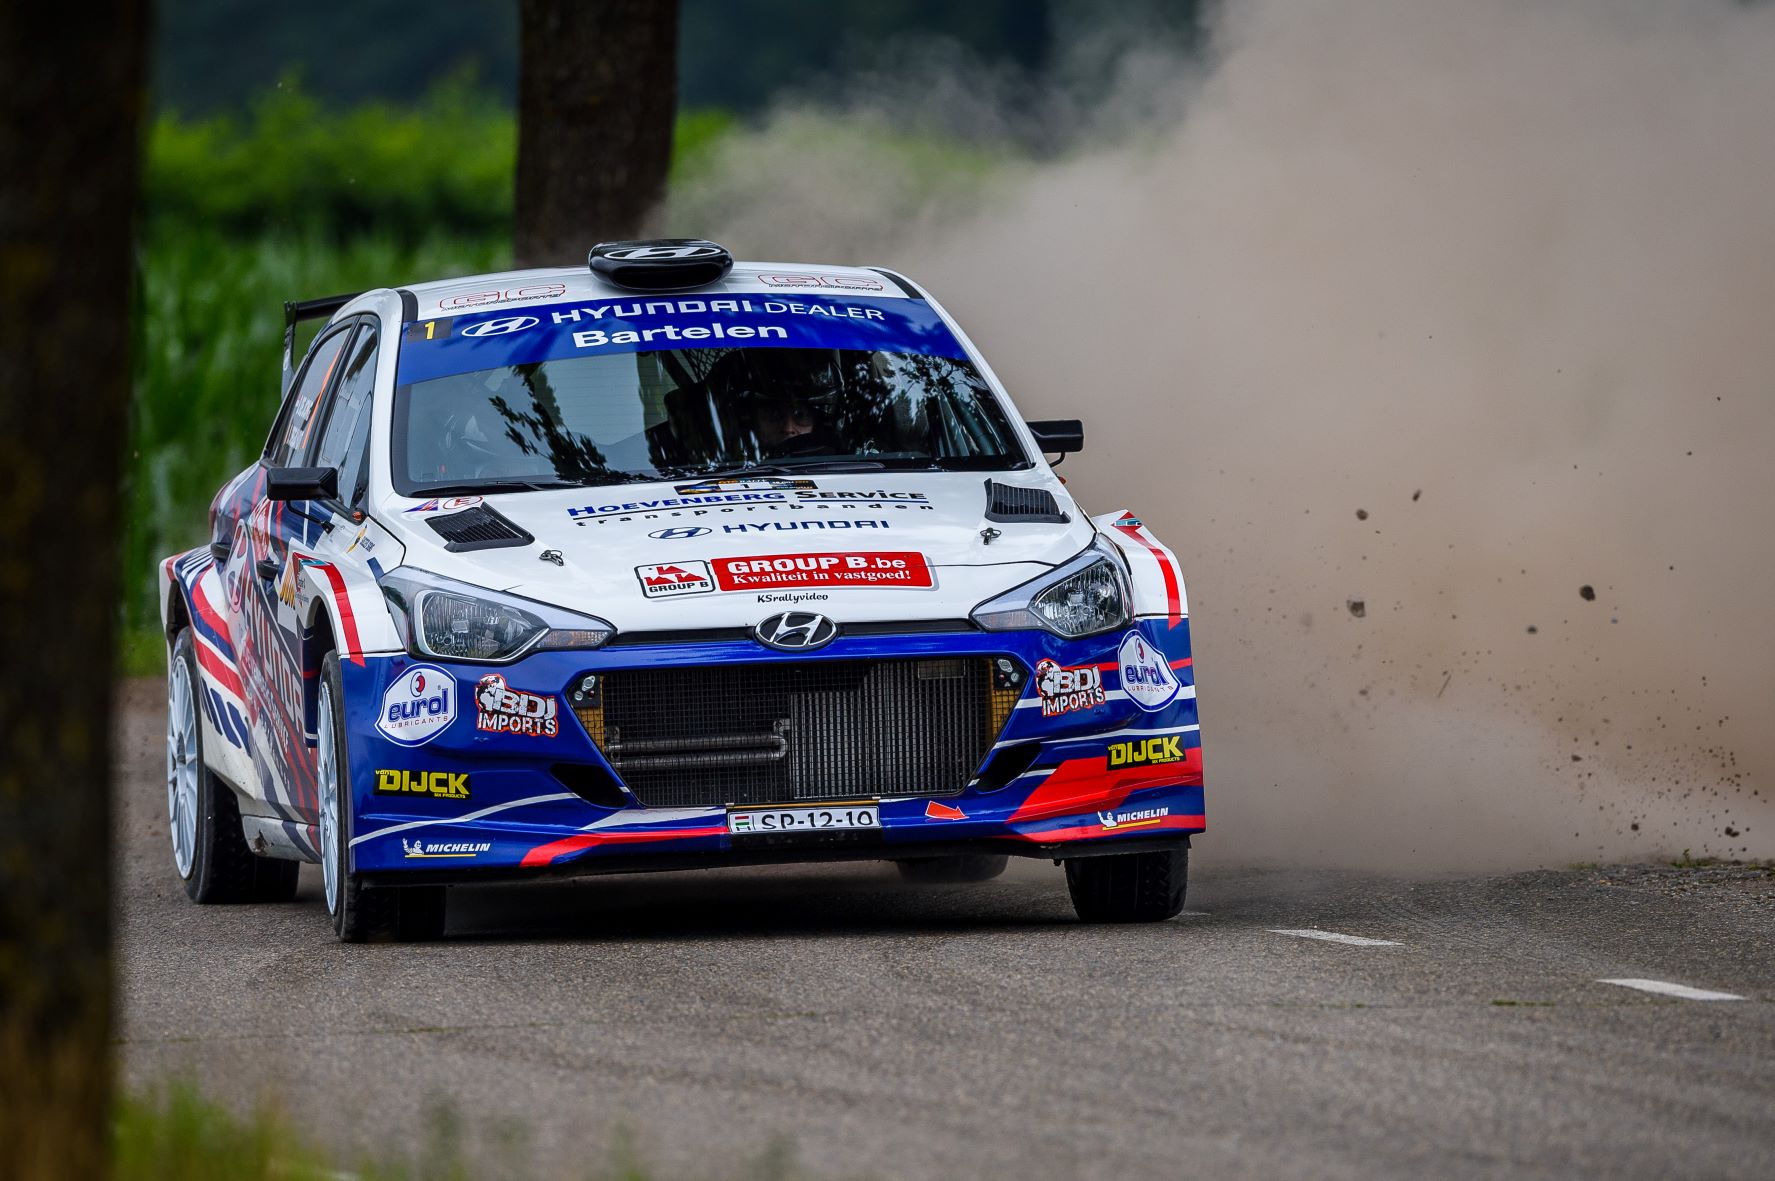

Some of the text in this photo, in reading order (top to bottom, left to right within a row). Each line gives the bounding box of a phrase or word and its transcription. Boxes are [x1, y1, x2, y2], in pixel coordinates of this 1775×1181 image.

[551, 300, 753, 324] HYUNDAI
[764, 302, 885, 320] DEALER
[424, 321, 437, 340] 1
[572, 322, 788, 348] Bartelen
[567, 493, 785, 517] HOEVENBERG
[723, 520, 890, 534] HYUNDAI
[727, 556, 906, 574] GROUP B.be
[733, 570, 912, 584] Kwaliteit in vastgoed!
[649, 582, 696, 593] GROUP
[757, 593, 829, 604] KSrallyvideo
[1125, 661, 1170, 687] eurol
[1128, 685, 1174, 693] LUBRICANTS
[388, 688, 449, 722] eurol
[1043, 687, 1105, 716] IMPORTS
[384, 716, 448, 729] LUBRICANTS
[478, 713, 556, 735] IMPORTS
[1111, 736, 1184, 766] DIJCK
[379, 769, 470, 795] DIJCK
[761, 810, 874, 830] SP-12-10
[1117, 807, 1169, 822] MICHELIN
[426, 843, 490, 853] MICHELIN
